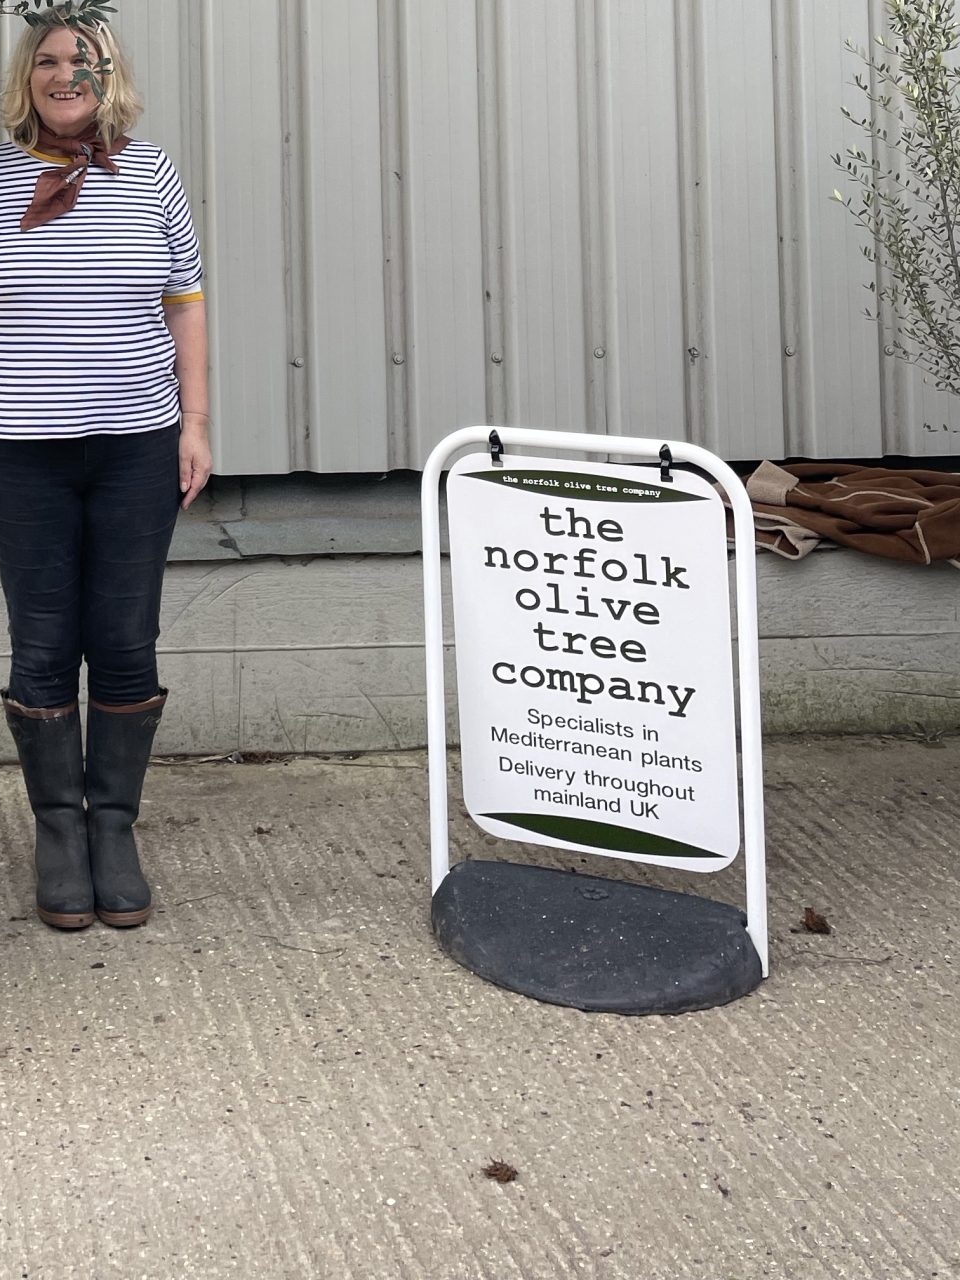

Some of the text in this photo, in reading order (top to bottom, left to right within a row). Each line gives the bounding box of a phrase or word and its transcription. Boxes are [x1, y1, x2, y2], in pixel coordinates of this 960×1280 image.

[502, 475, 661, 499] the norfolk olive tree company
[539, 506, 624, 543] the
[484, 545, 691, 590] norfolk
[515, 582, 660, 625] olive
[532, 621, 647, 663] tree
[492, 661, 696, 718] company
[527, 708, 659, 742] Specialists in
[491, 726, 703, 773] Mediterranean plants
[499, 756, 696, 802] Delivery throughout
[534, 788, 660, 820] mainland UK
